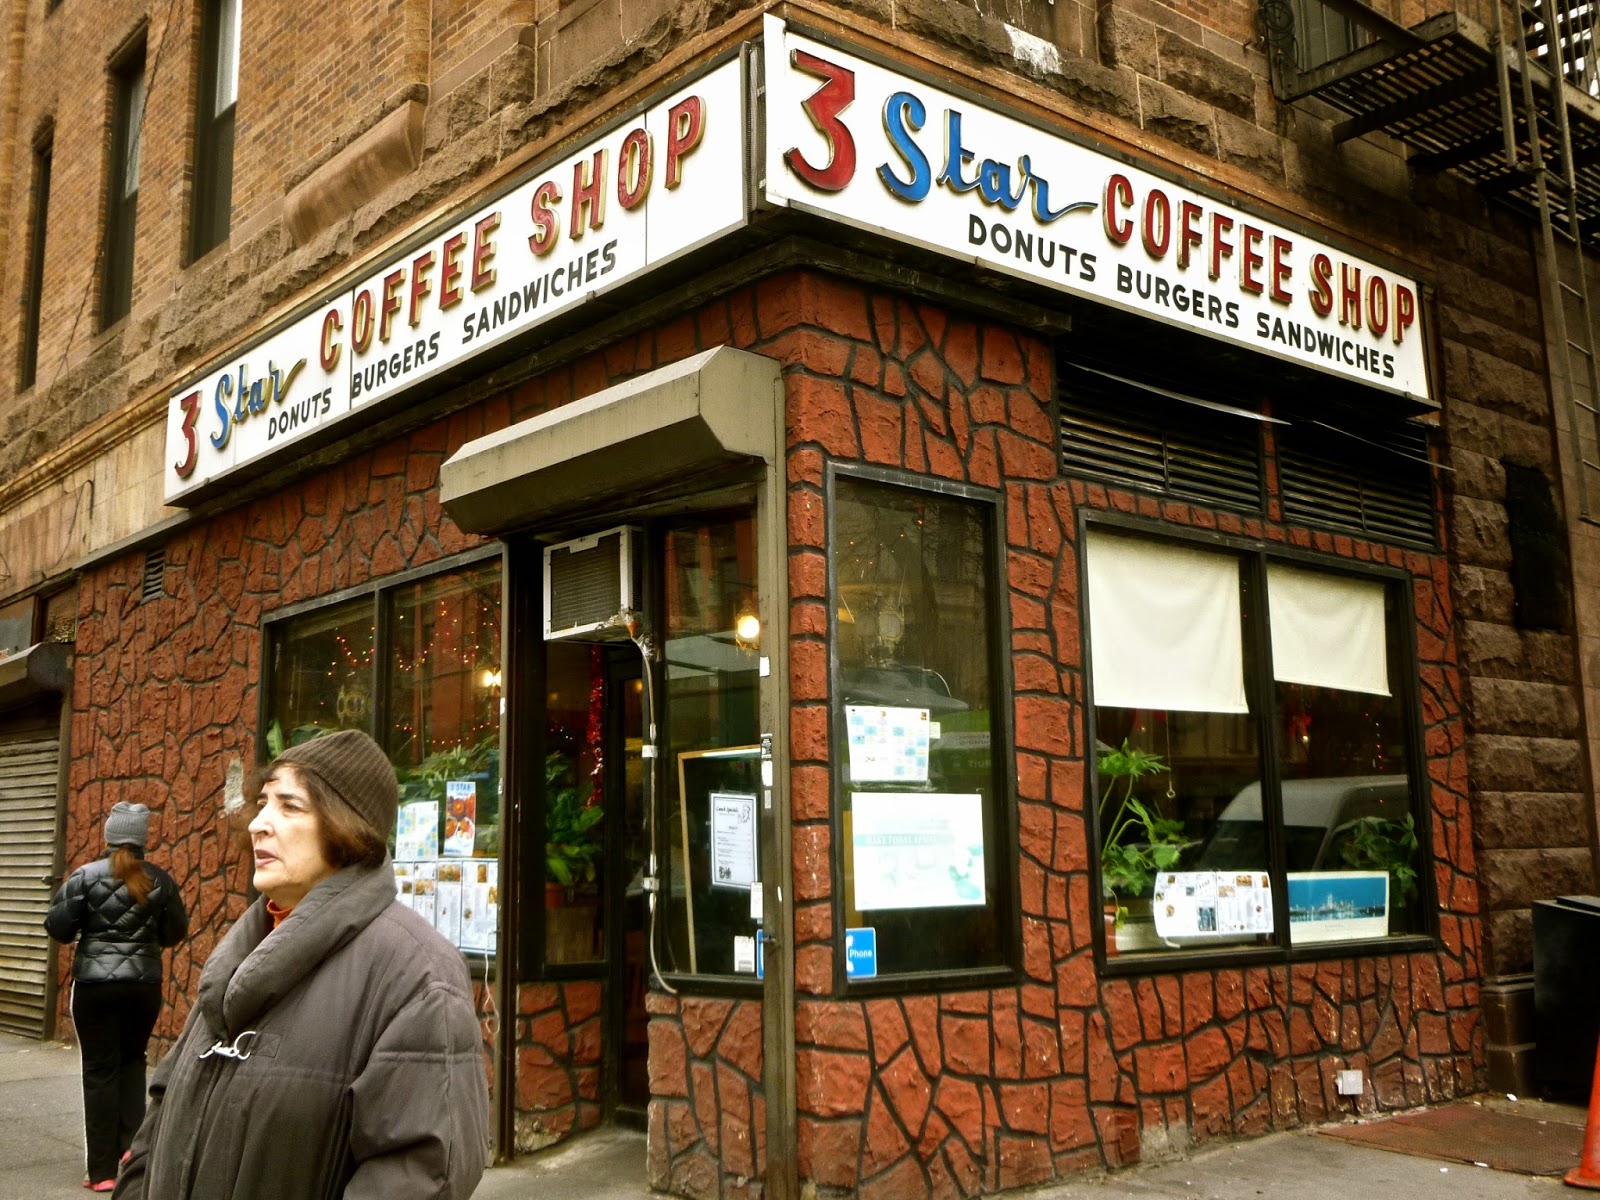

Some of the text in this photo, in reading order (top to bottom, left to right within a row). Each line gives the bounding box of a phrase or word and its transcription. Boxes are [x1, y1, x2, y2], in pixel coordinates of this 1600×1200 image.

[174, 95, 706, 478] 3 Star COFFEE SHOP
[783, 48, 1415, 344] 3 Star COFFEE SHOP
[968, 213, 1395, 379] DONUTS BURGERS SANDWICHES
[268, 238, 618, 441] DONUTS BURGERS SANDWICHES
[849, 949, 873, 958] Phone
